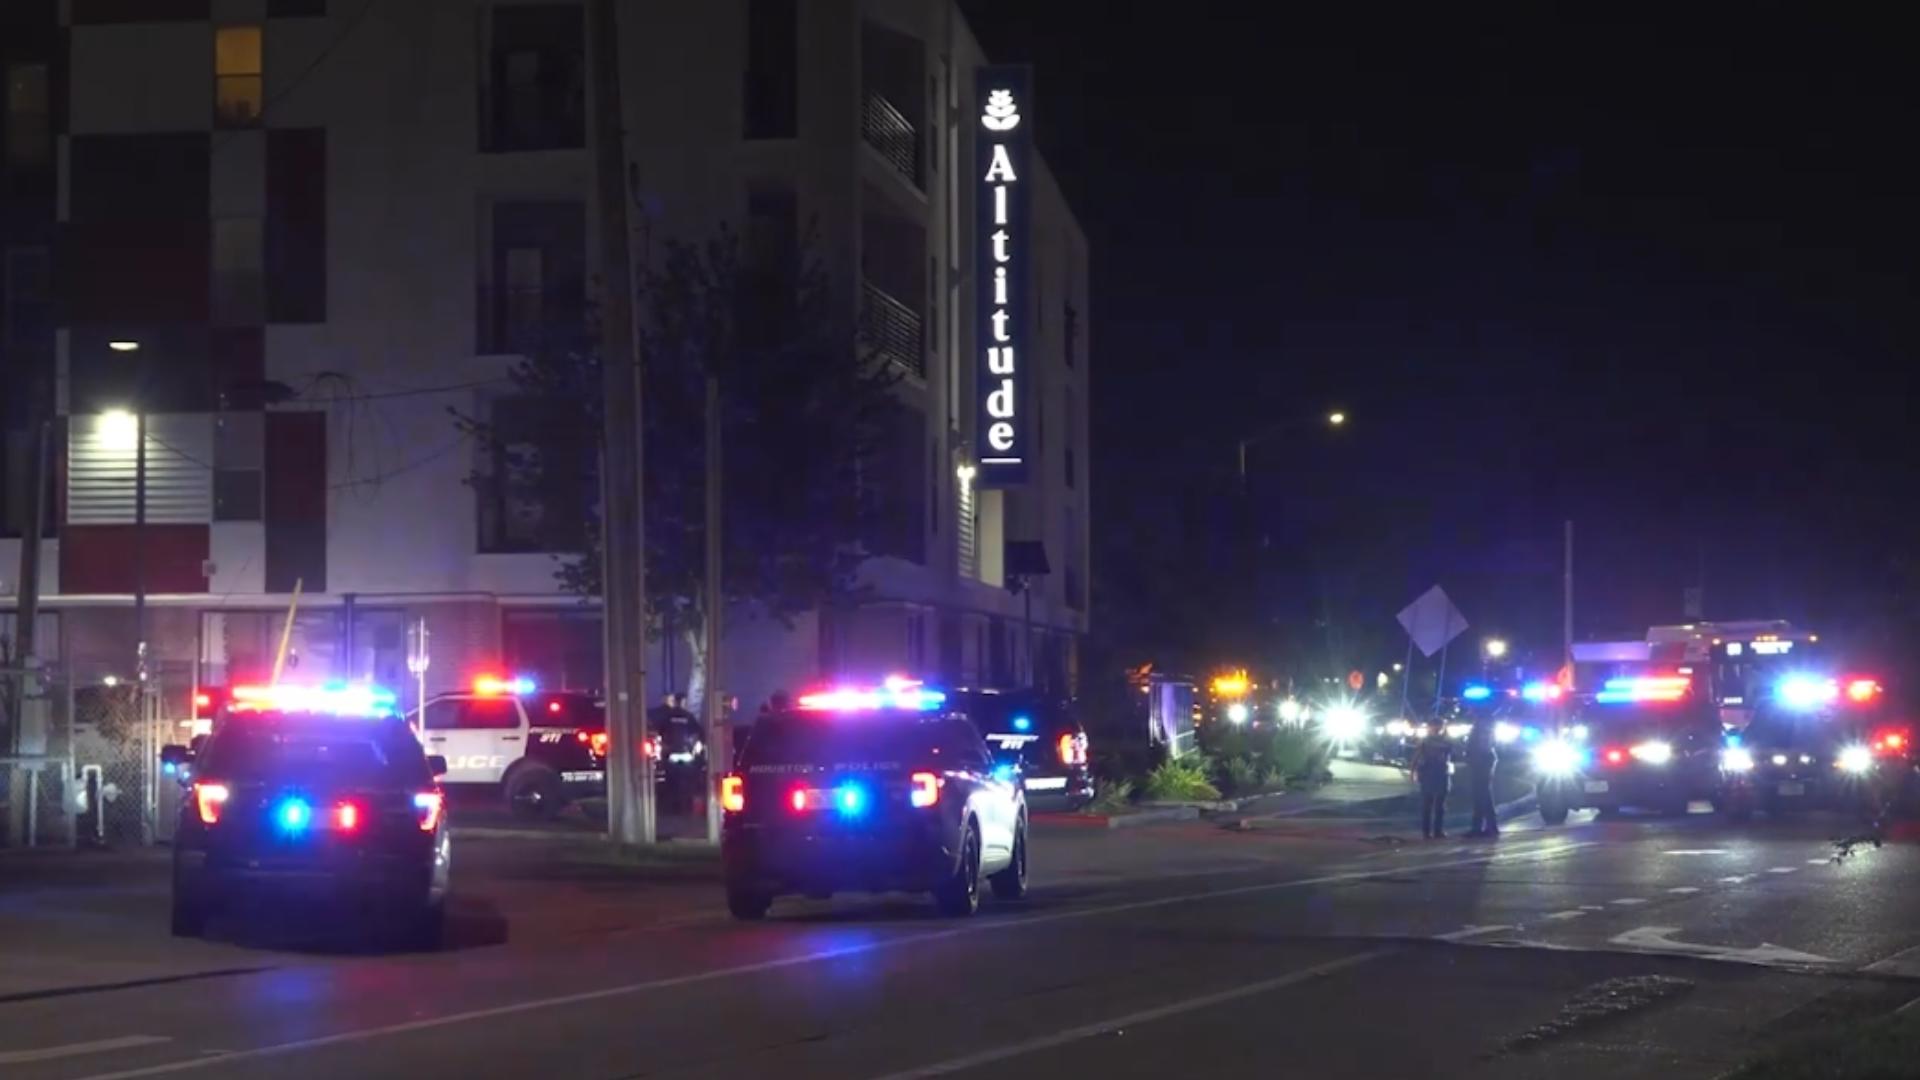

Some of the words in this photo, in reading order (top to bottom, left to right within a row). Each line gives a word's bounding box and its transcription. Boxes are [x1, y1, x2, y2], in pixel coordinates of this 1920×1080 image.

[984, 144, 1017, 451] Altitude
[446, 755, 505, 769] LICE
[833, 761, 901, 771] POLICE
